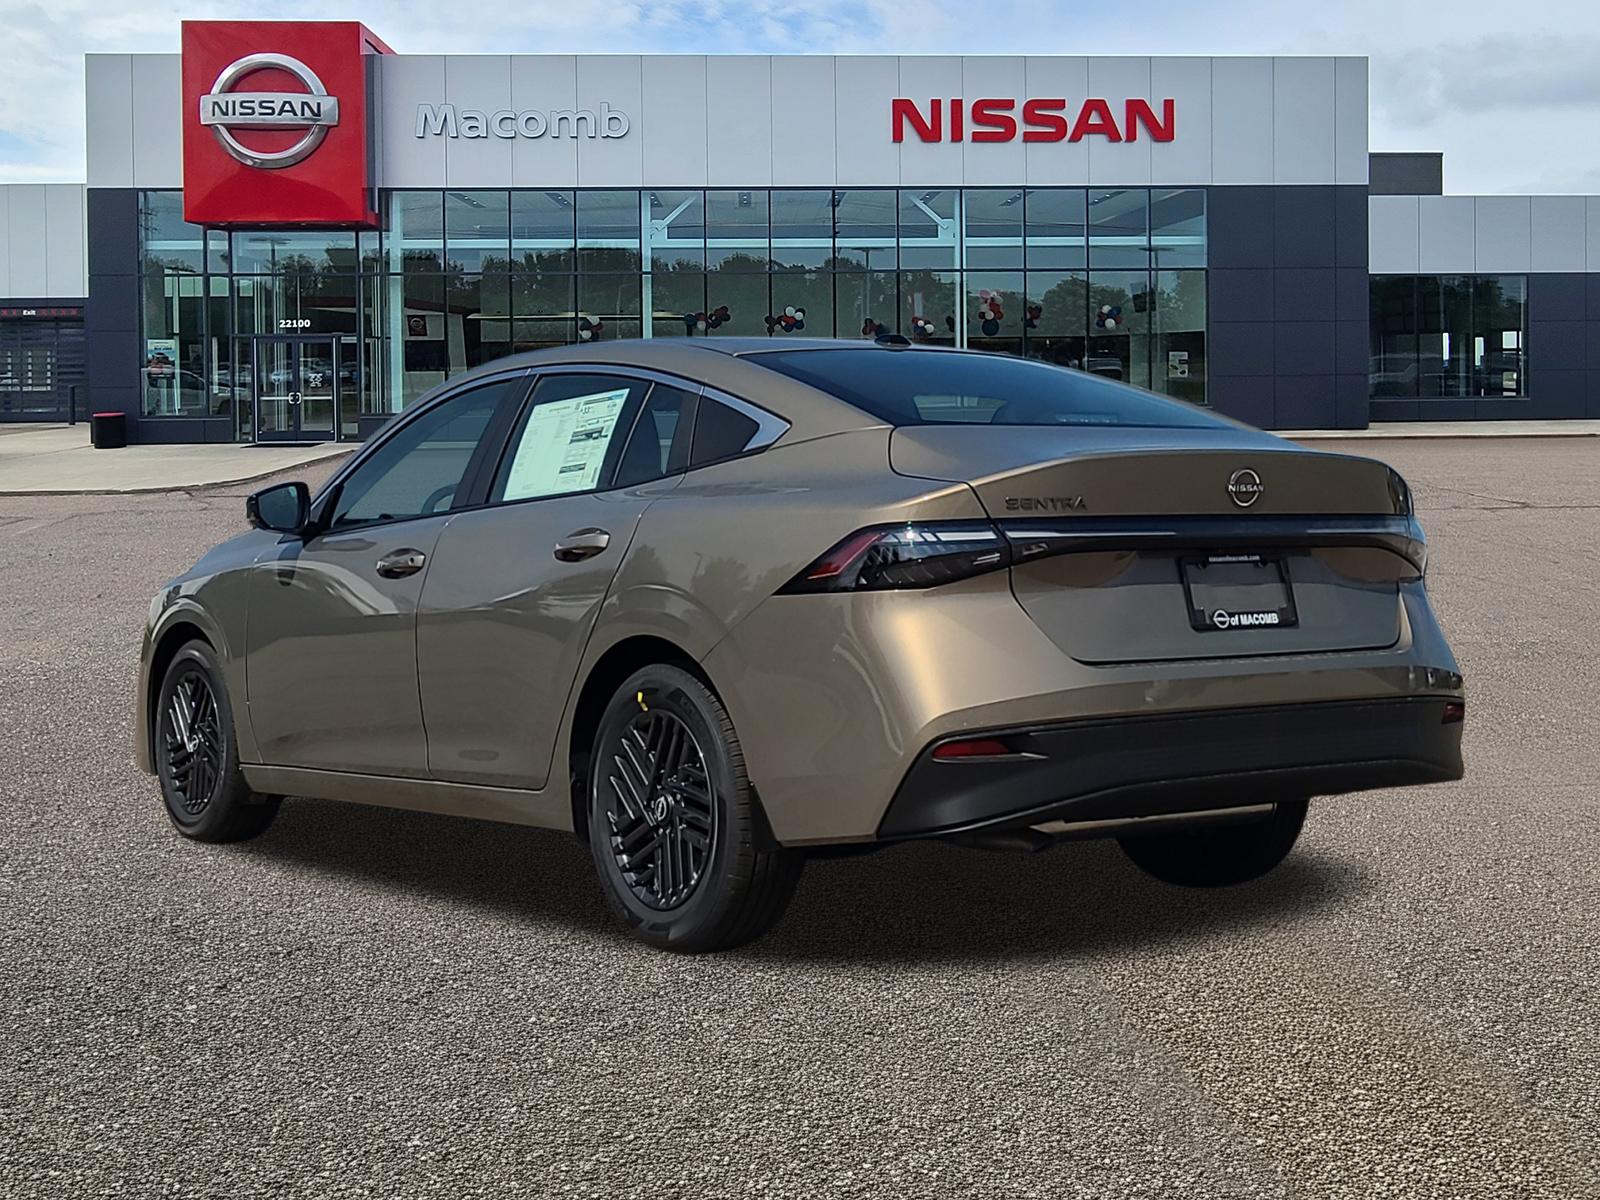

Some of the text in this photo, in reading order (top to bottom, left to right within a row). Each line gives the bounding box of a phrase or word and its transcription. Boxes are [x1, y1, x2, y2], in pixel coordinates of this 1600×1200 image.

[211, 99, 322, 118] NISSAN
[415, 101, 630, 139] Macomb
[892, 98, 1176, 142] NISSAN
[279, 319, 311, 328] 22100
[1228, 484, 1264, 492] NISSAN
[1005, 496, 1087, 511] SENTRA
[1230, 612, 1279, 626] of MACOMB
